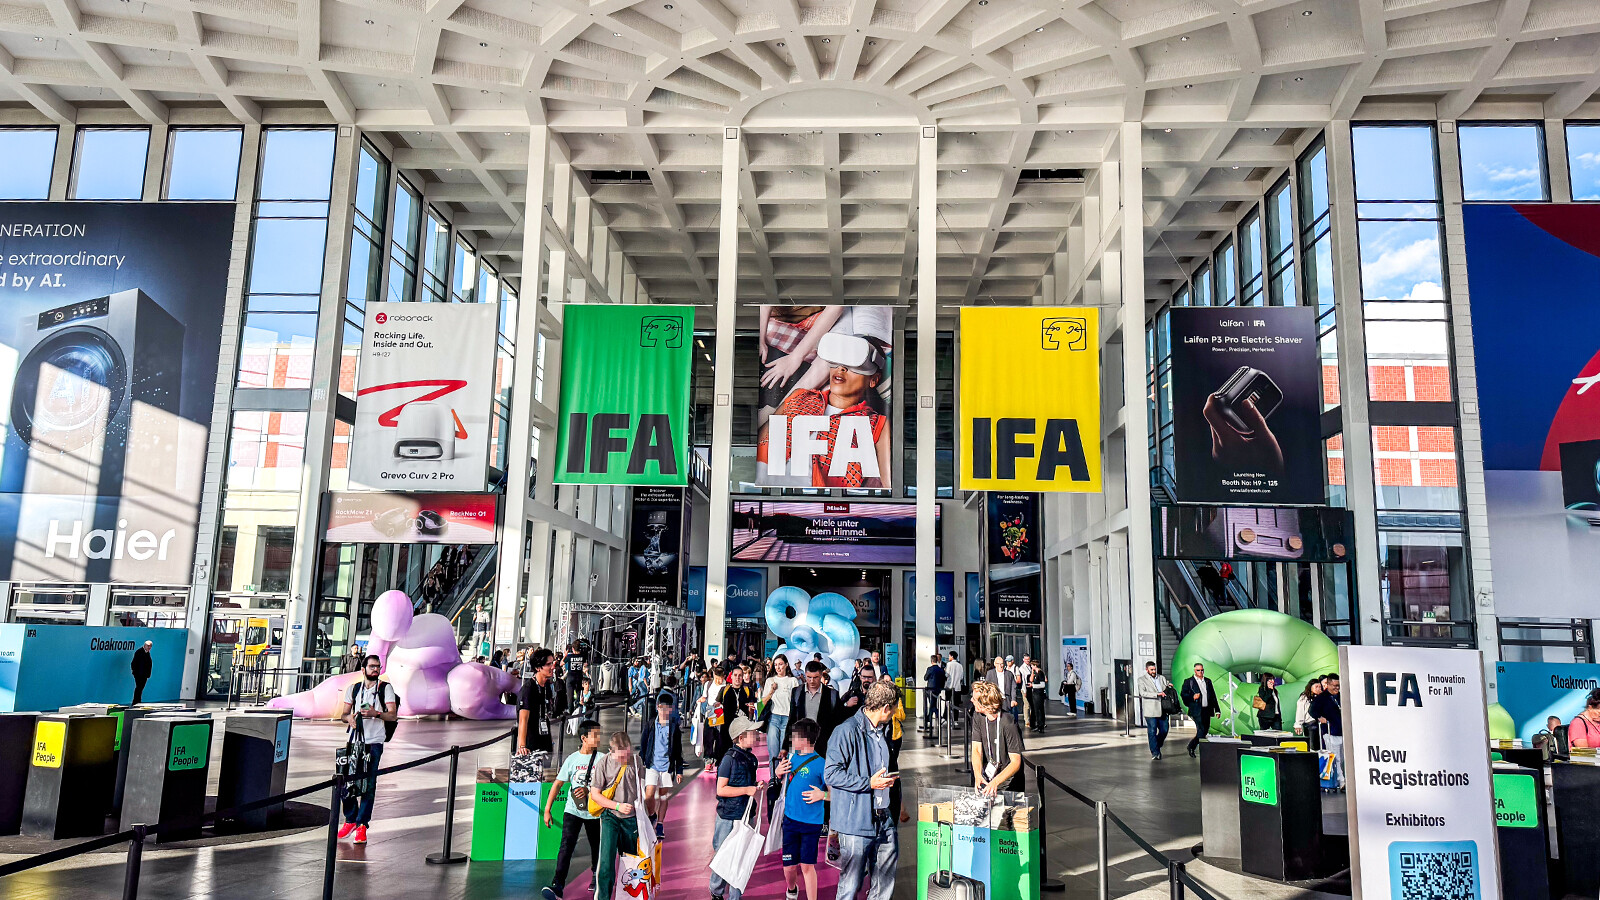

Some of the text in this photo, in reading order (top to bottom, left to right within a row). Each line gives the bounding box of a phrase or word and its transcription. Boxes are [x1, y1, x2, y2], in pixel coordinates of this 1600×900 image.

[8, 251, 126, 270] extraordinary
[12, 273, 35, 292] by
[39, 273, 67, 288] AI.
[373, 331, 425, 341] Rocking Life.
[1183, 336, 1303, 344] Laifen P3 Pro Electric Shaver
[416, 341, 434, 349] Out.
[566, 412, 678, 475] IFA
[767, 414, 881, 478] IFA
[972, 417, 1091, 482] IFA
[380, 471, 455, 480] Qrevo Curv 2 Pro
[812, 518, 860, 528] Miele unter
[805, 527, 868, 537] freiem Himmel.
[44, 518, 177, 561] Haier
[998, 607, 1032, 619] Haier
[27, 629, 37, 637] IFA
[90, 637, 136, 651] Cloakroom
[1427, 673, 1466, 685] Innovation
[1550, 674, 1598, 691] Cloakroom
[1363, 671, 1424, 708] IFA
[1428, 686, 1453, 696] For All
[37, 742, 46, 751] IFA
[174, 746, 186, 755] IFA
[35, 752, 56, 764] People
[1367, 745, 1407, 764] New
[172, 755, 199, 767] People
[1244, 776, 1256, 787] IFA
[1368, 767, 1470, 790] Registrations
[1245, 786, 1269, 800] People
[1385, 812, 1446, 827] Exhibitors
[1496, 811, 1526, 824] eople
